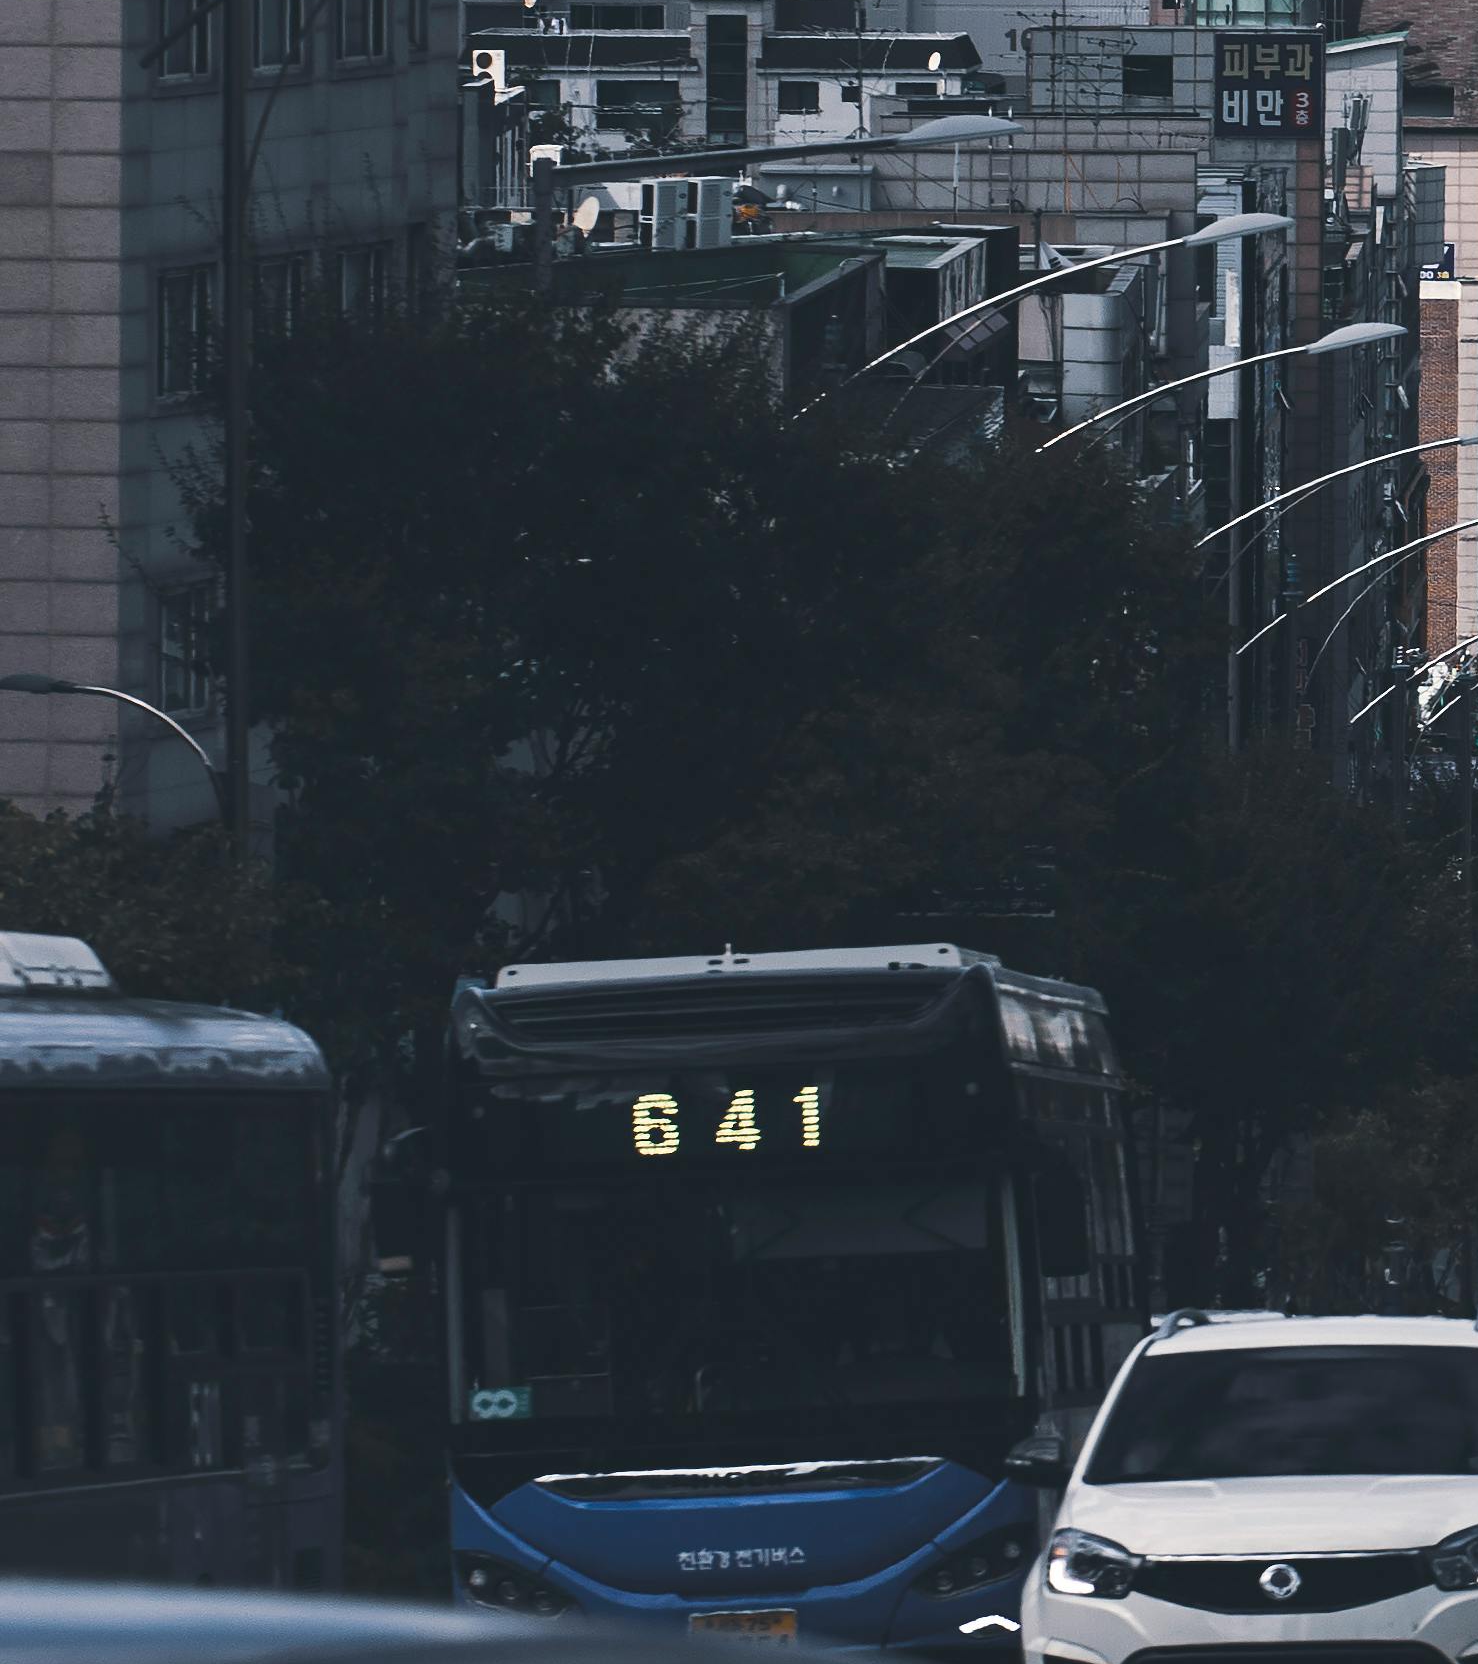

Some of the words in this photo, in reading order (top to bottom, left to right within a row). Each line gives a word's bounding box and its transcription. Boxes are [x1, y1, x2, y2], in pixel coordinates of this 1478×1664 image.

[1222, 43, 1313, 81] 피부과
[1222, 89, 1285, 127] 비만
[632, 1085, 821, 1156] 641
[735, 1546, 807, 1569] 전기버스
